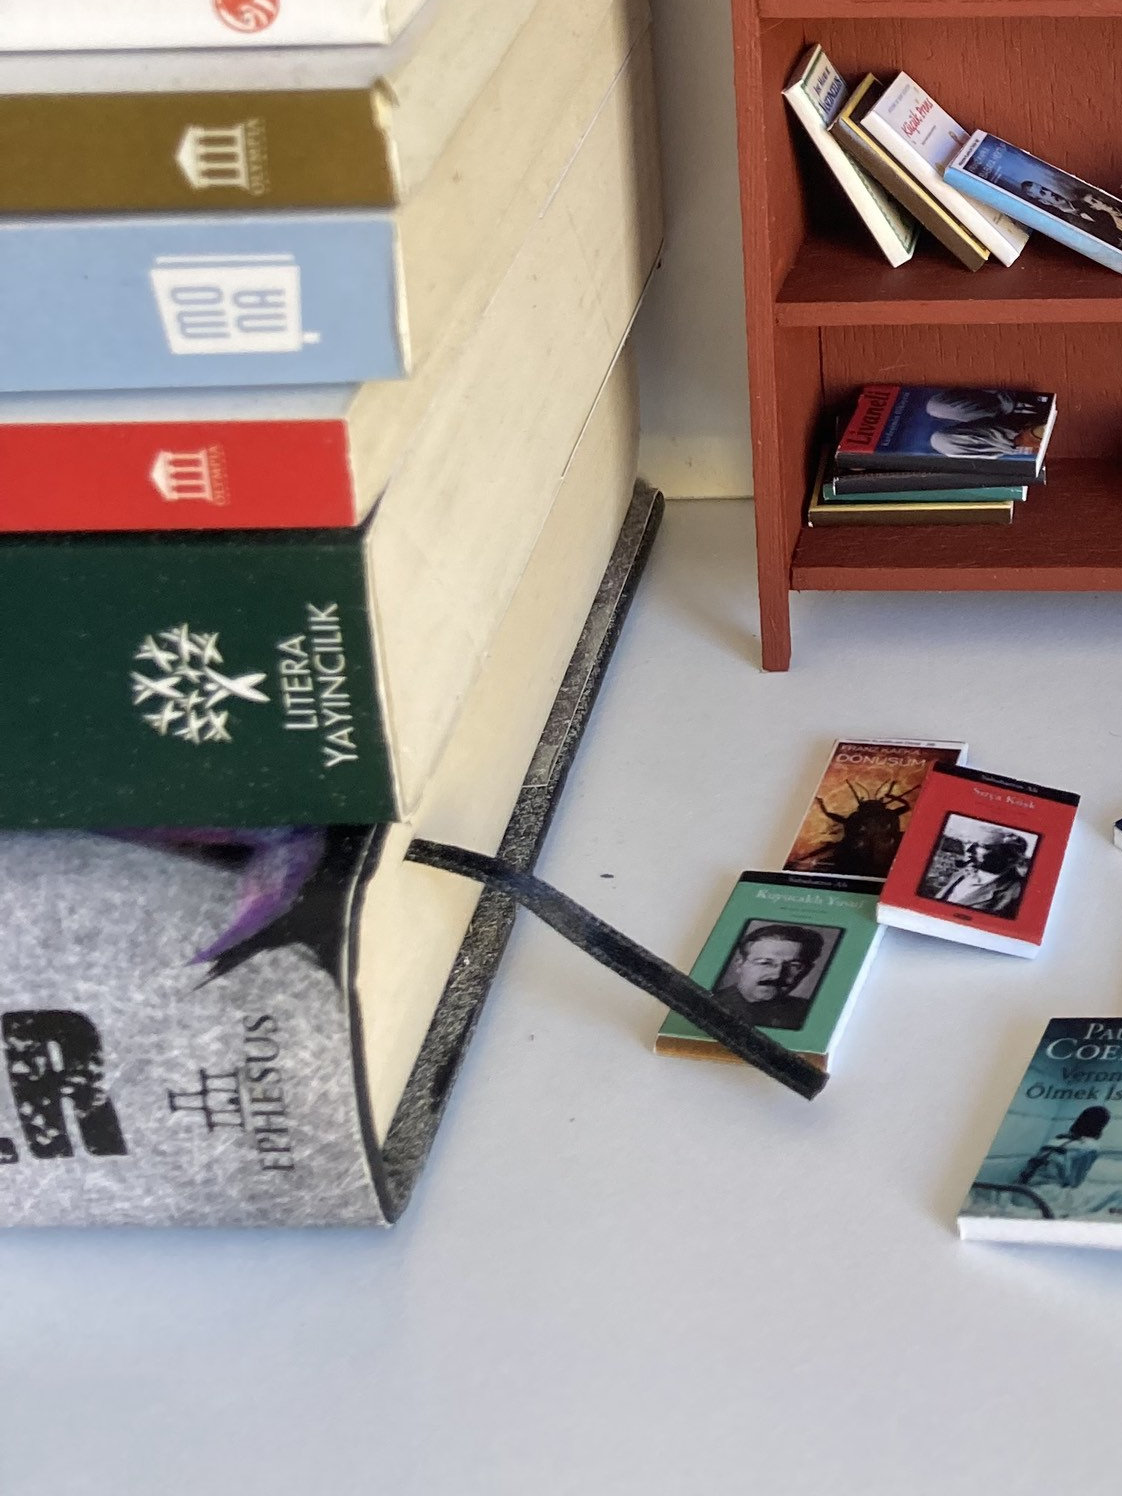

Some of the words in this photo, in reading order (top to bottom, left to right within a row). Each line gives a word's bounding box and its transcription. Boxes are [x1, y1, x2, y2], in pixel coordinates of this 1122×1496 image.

[848, 391, 891, 446] Livaneli
[275, 634, 319, 730] LITERA
[305, 602, 359, 767] YAYINCILIK
[243, 1014, 294, 1172] EPHESUS
[1025, 1082, 1100, 1100] Ölmek
